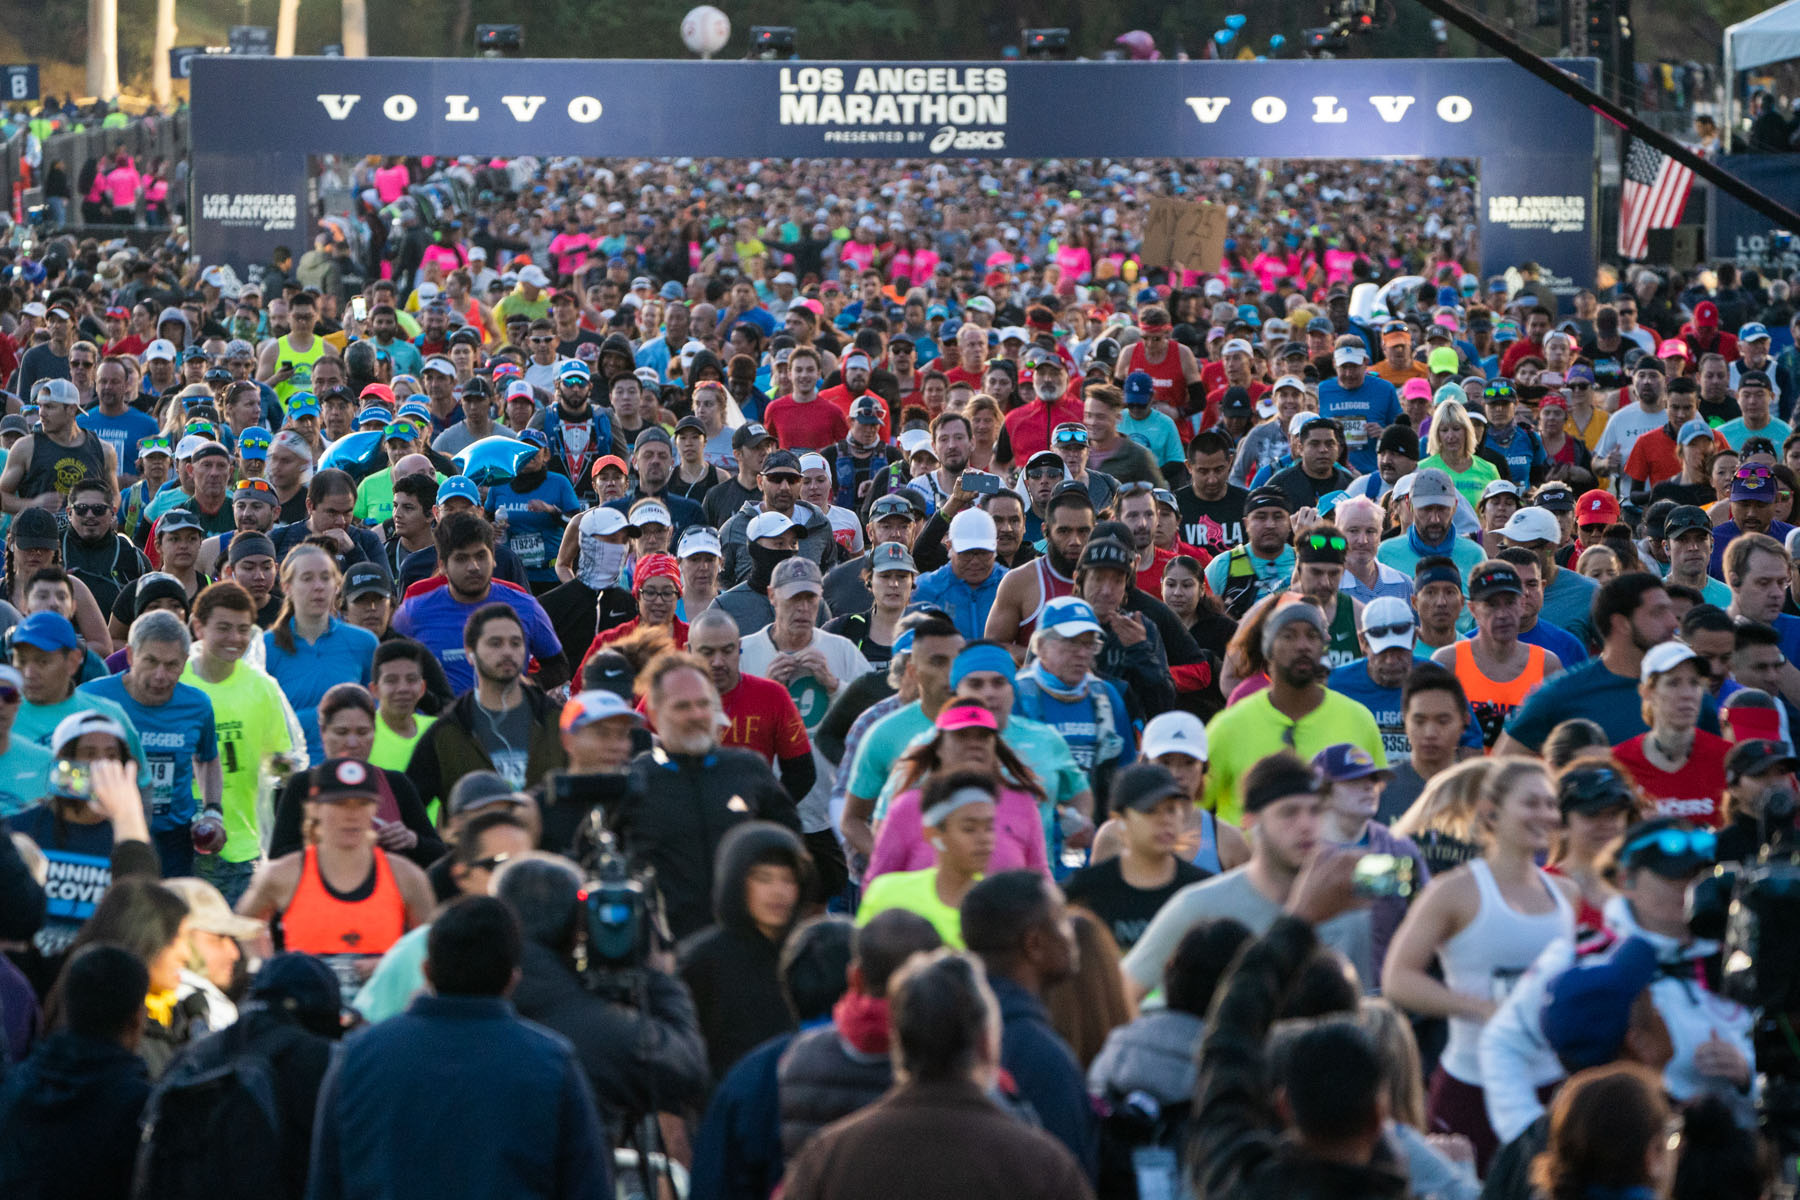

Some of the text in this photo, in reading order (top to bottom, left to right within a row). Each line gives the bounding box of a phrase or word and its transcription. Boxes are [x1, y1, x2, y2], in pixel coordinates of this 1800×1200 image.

[11, 74, 28, 99] B
[780, 68, 1007, 93] LOS ANGELES
[317, 95, 603, 123] VOLVO
[780, 95, 1007, 125] MARATHON
[1185, 96, 1472, 123] VOLVO
[824, 131, 904, 143] PRESENTED
[907, 131, 925, 143] BY
[203, 206, 297, 220] MARATHON
